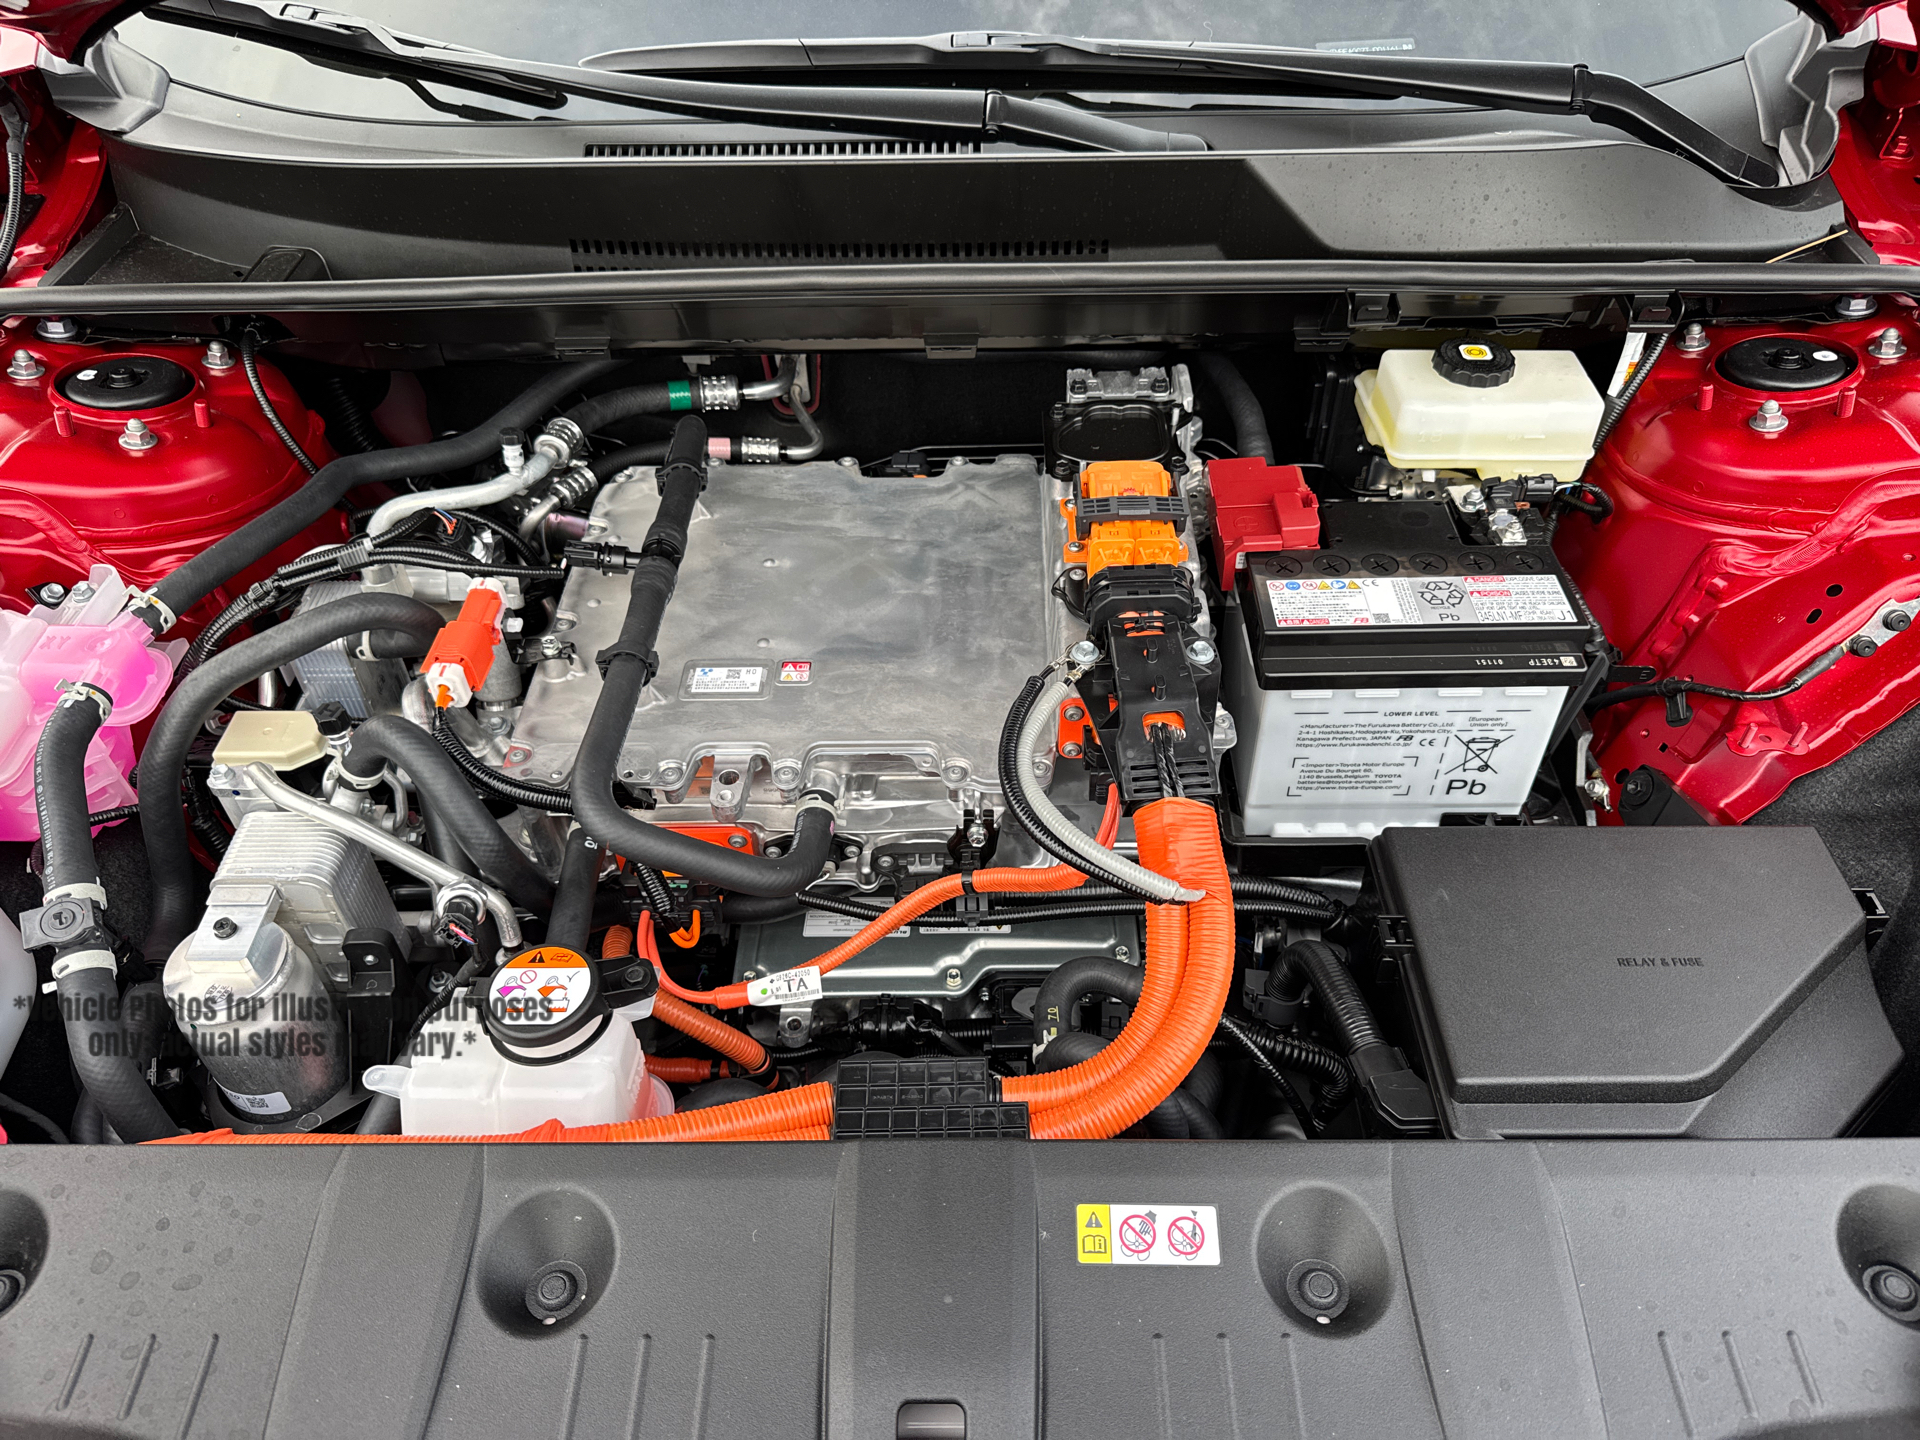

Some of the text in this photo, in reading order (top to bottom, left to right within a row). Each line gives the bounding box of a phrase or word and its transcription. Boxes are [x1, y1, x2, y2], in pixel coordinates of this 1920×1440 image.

[1438, 612, 1460, 622] Pb
[1445, 779, 1487, 796] Pb
[1617, 957, 1704, 967] RELAY & FUSE
[783, 977, 808, 993] TA
